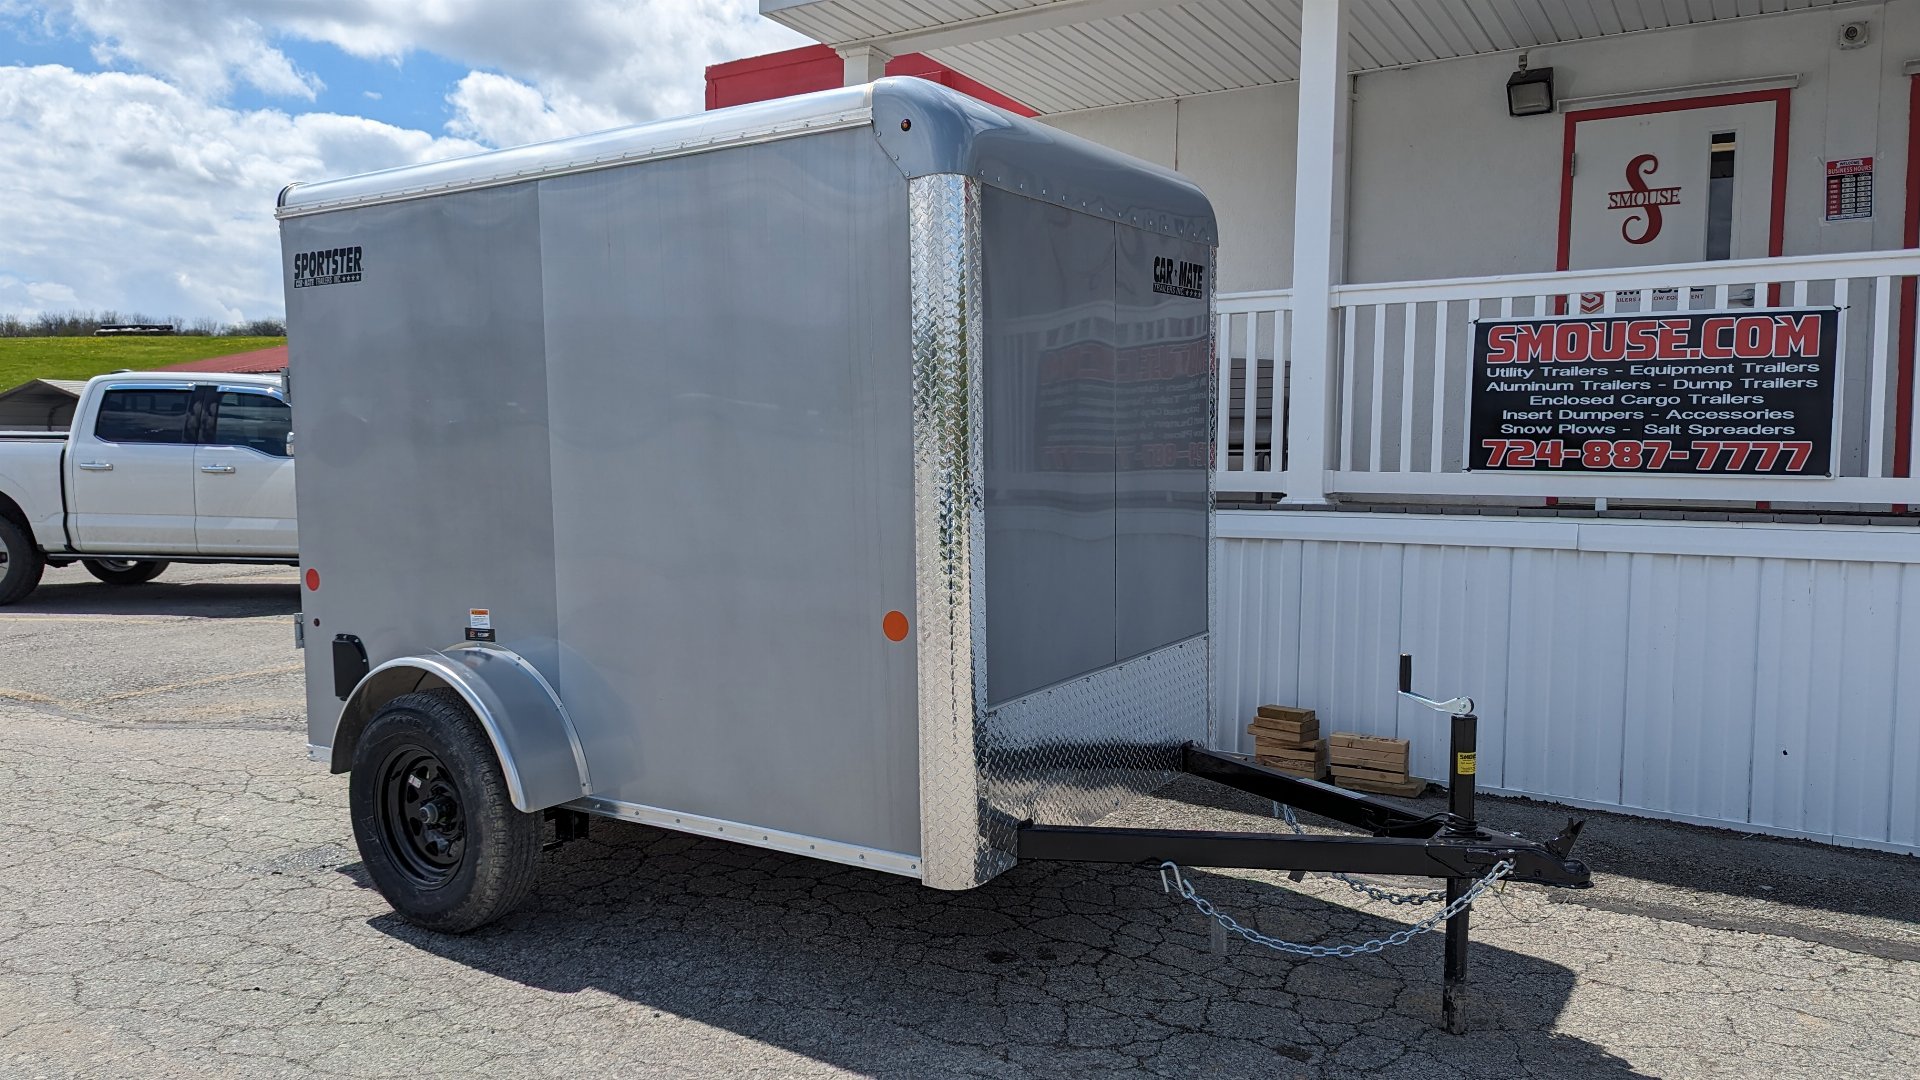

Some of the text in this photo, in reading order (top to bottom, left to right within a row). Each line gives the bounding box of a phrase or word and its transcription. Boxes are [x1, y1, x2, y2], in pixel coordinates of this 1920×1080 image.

[1828, 167, 1853, 175] BUSINESS
[1609, 188, 1681, 208] SMOUSE
[294, 246, 362, 280] SPORTSTER
[1486, 314, 1822, 364] SMOUSE.COM
[1486, 367, 1534, 379] Utility
[1540, 365, 1609, 376] Trailers
[1630, 363, 1735, 377] Equipment
[1742, 361, 1820, 373] Trailers
[1485, 381, 1574, 392] Aluminum
[1581, 379, 1651, 391] Trailers
[1673, 379, 1733, 391] Dump
[1740, 377, 1819, 389] Trailers
[1529, 393, 1765, 407] Enclosed Cargo Trailers
[1502, 409, 1552, 420] Insert
[1559, 409, 1644, 421] Dumpers
[1665, 409, 1795, 420] Accessories
[1500, 424, 1552, 434] Snow
[1558, 424, 1616, 434] Plows
[1644, 424, 1682, 435] Salt
[1688, 424, 1796, 436] Spreaders
[1482, 439, 1813, 471] 724-887-7777
